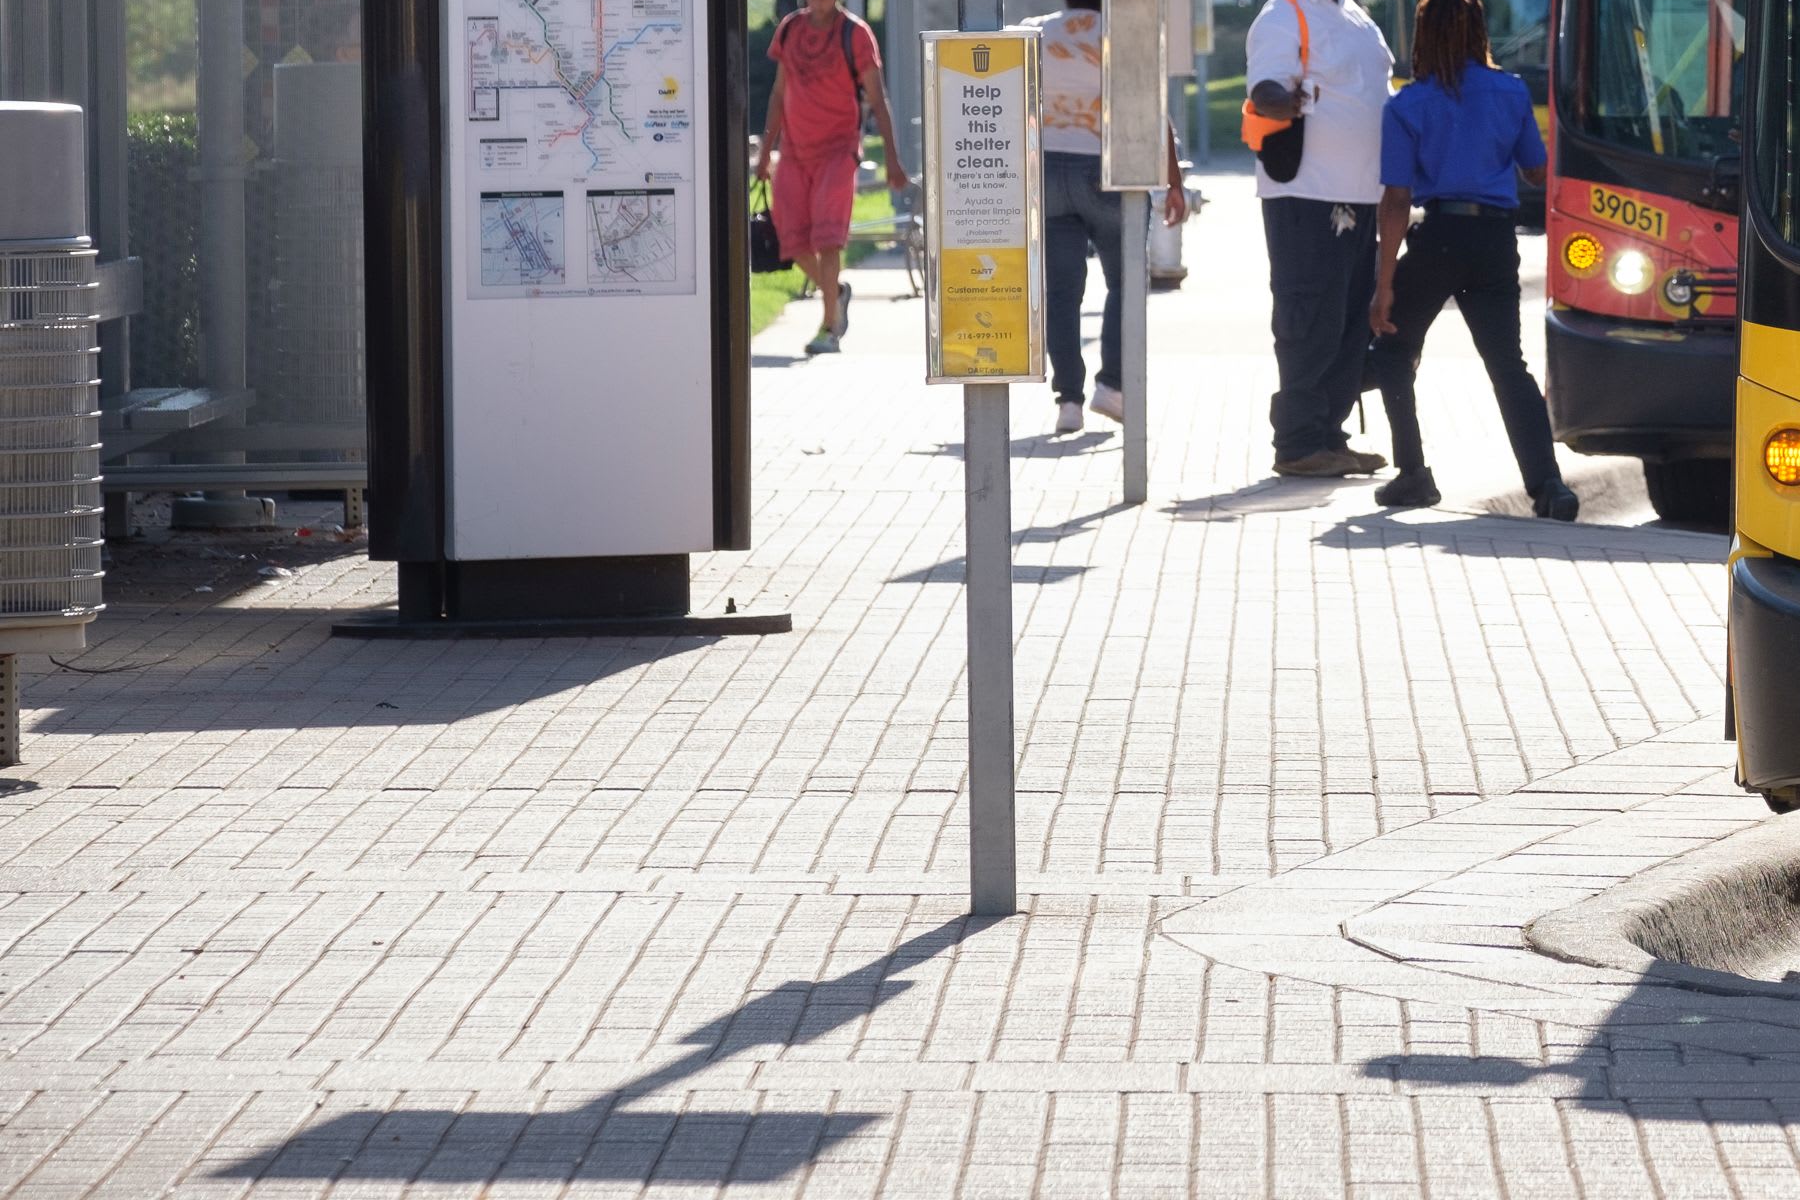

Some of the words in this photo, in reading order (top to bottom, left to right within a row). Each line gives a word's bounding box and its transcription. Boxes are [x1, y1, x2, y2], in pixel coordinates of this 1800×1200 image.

[962, 85, 1002, 101] Help
[961, 102, 1003, 118] keep
[967, 120, 997, 133] this
[954, 137, 1011, 151] shelter
[956, 155, 1009, 169] clean.
[954, 172, 982, 181] there's
[958, 181, 970, 190] let
[982, 181, 1008, 190] know.
[964, 197, 995, 207] Ayuda
[946, 208, 990, 216] mantener
[1592, 187, 1664, 238] 39051
[947, 286, 989, 294] Customer
[991, 285, 1023, 294] Service
[957, 332, 1012, 340] 214-979-1111
